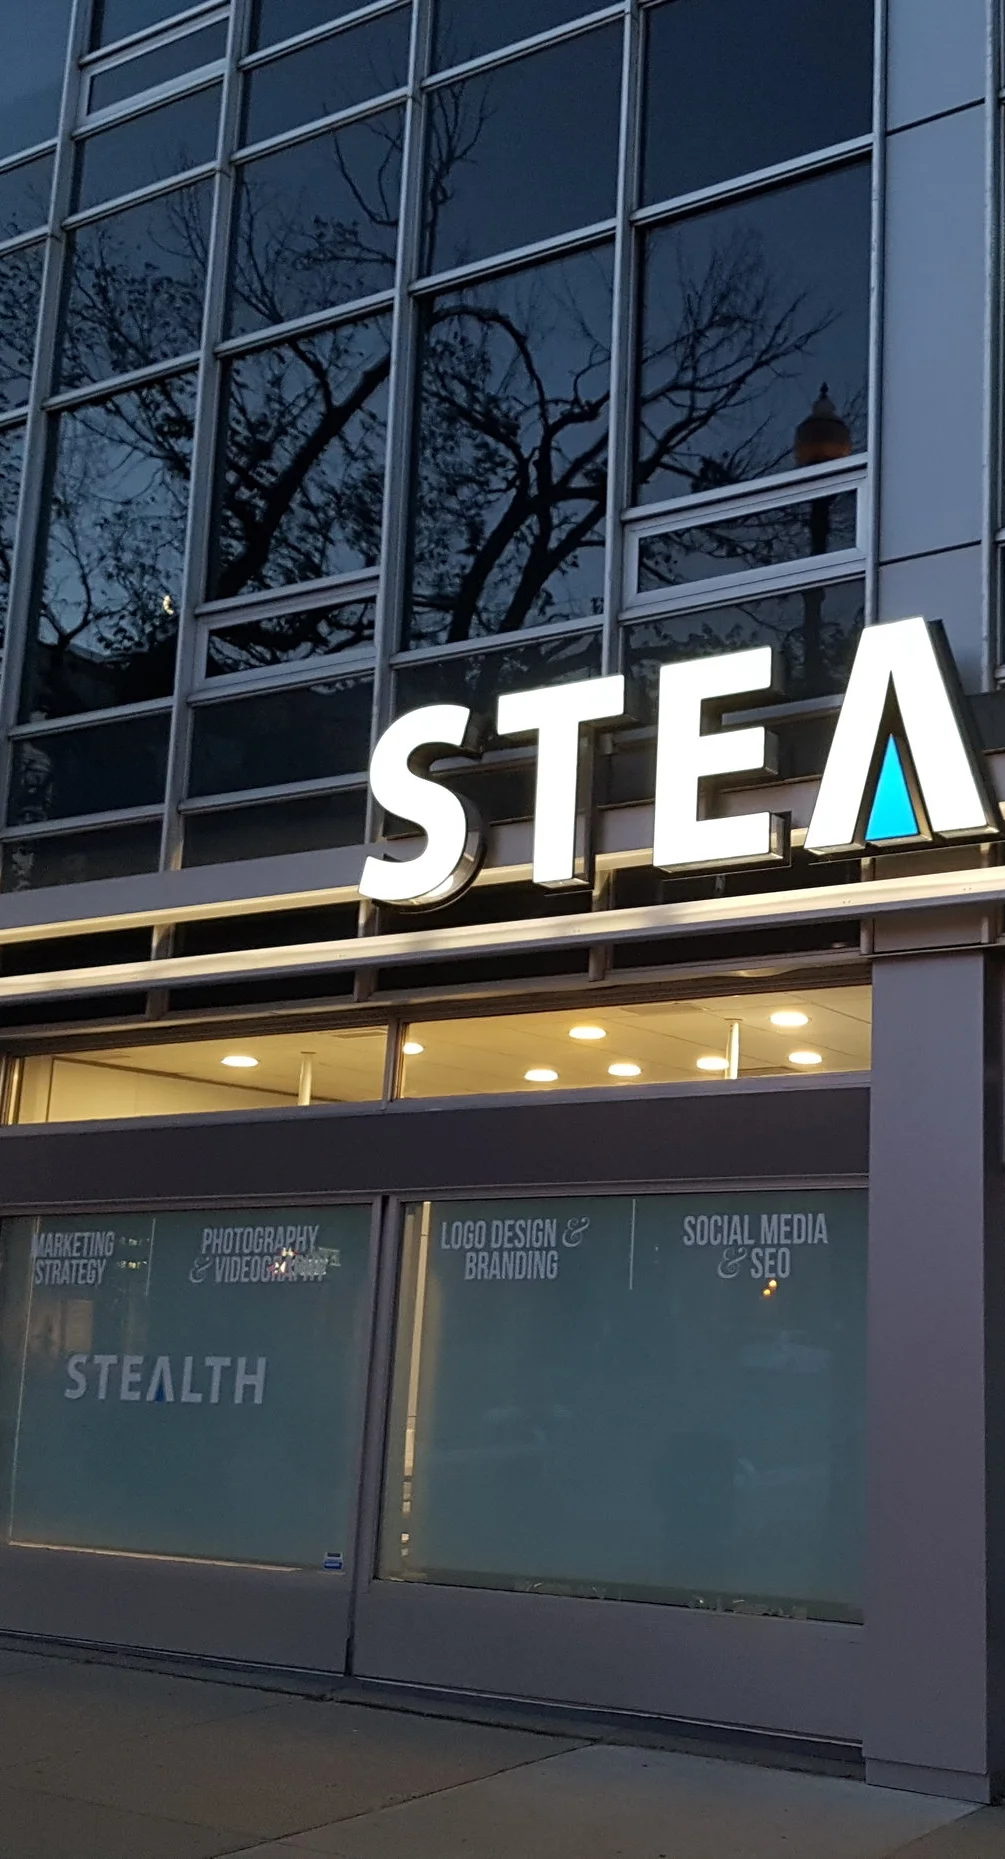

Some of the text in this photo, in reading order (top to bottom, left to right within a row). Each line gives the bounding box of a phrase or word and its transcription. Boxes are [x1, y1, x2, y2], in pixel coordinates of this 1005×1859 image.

[31, 1231, 115, 1258] MARKETING
[201, 1225, 320, 1254] PHOTOGRAPHY
[440, 1217, 591, 1249] LOGO DESIGN &
[683, 1213, 829, 1246] SOCIAL MEDIA
[34, 1259, 107, 1285] STRATEGY
[189, 1255, 327, 1283] & VIDEOGRA
[464, 1250, 559, 1280] BRANDING
[717, 1247, 791, 1278] & SEO
[64, 1354, 268, 1405] STEALTH
